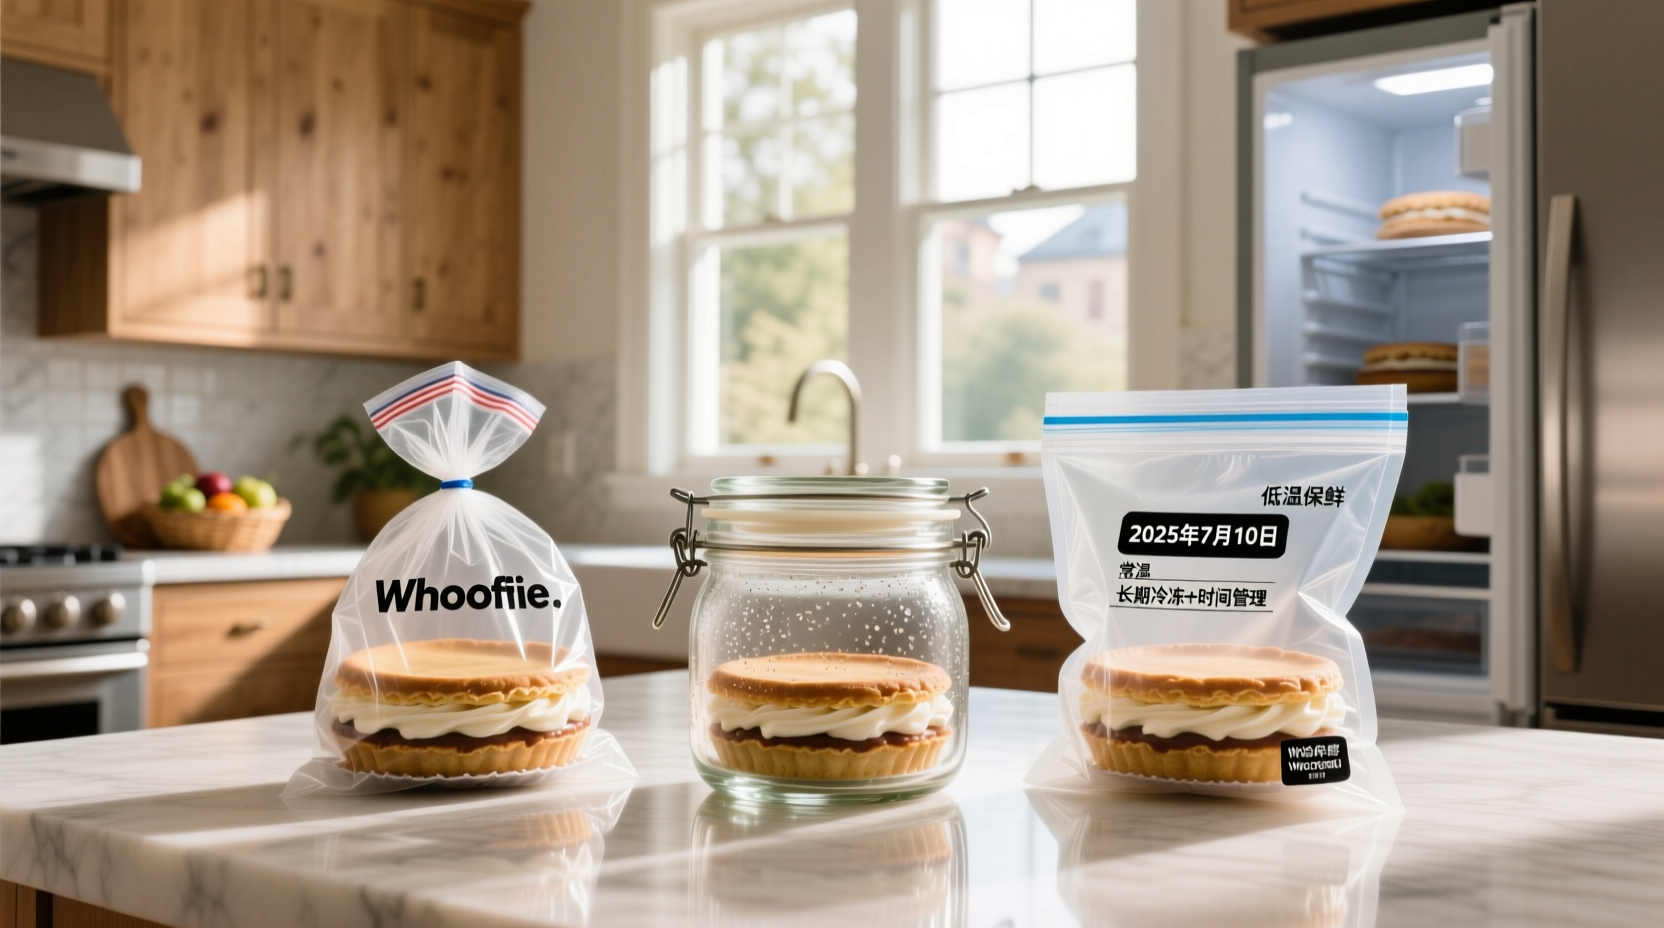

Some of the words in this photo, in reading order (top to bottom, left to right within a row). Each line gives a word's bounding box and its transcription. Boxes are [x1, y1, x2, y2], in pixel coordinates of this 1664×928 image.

[1261, 485, 1346, 508] 低温保鲜
[1128, 523, 1278, 547] 2025年7月10日
[1116, 584, 1267, 607] 长期冷冻+时间管理
